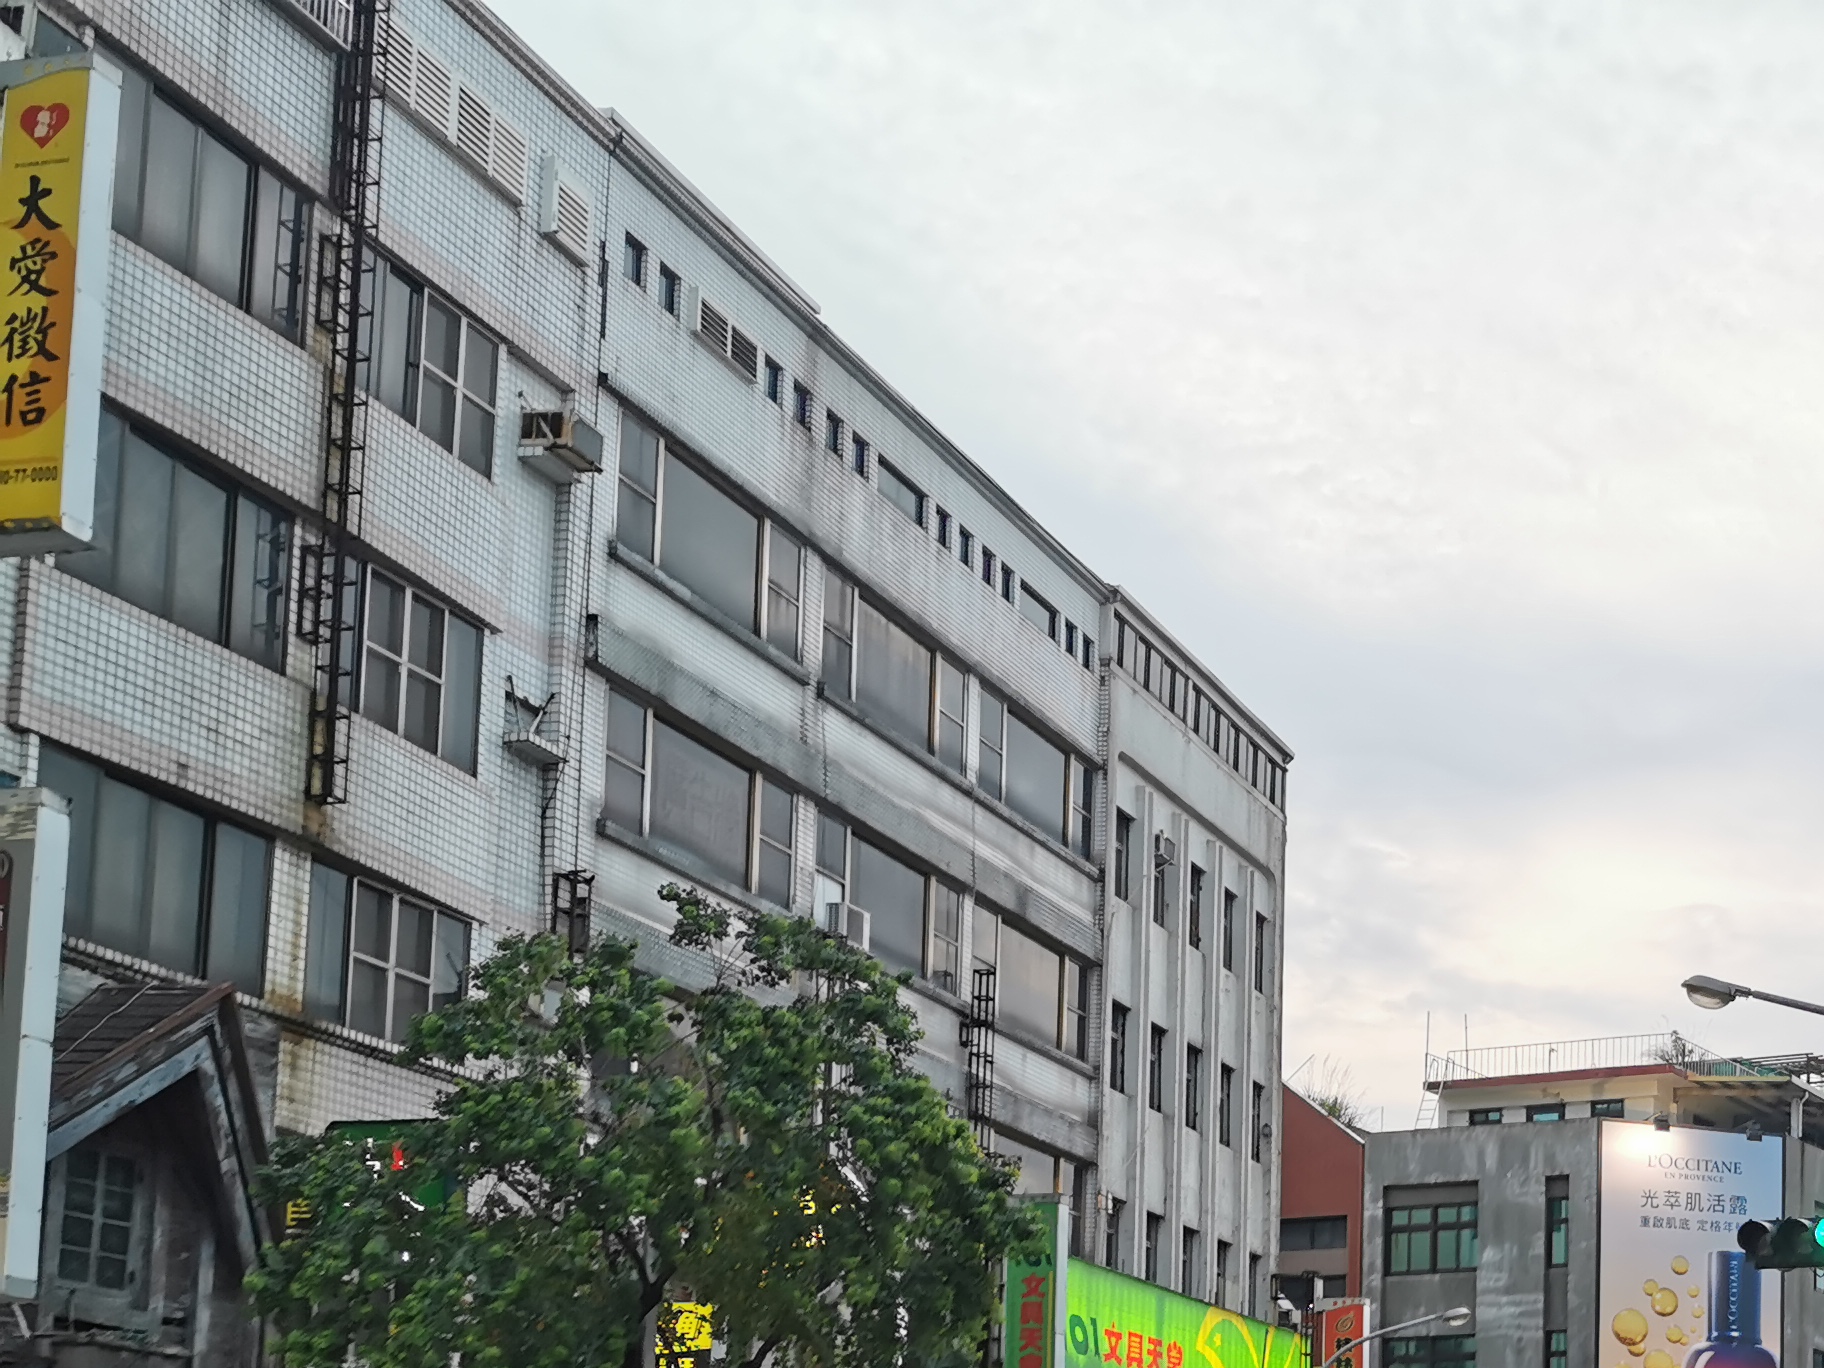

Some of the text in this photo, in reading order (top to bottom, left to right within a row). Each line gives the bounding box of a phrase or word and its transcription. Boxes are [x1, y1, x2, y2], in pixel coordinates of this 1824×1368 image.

[0, 174, 61, 427] 大愛徵信
[1648, 1153, 1743, 1176] L'OCCITANE
[1679, 1173, 1725, 1183] PROVENCE
[1640, 1189, 1748, 1216] 光萃肌活露
[1697, 1218, 1742, 1233] 定格年
